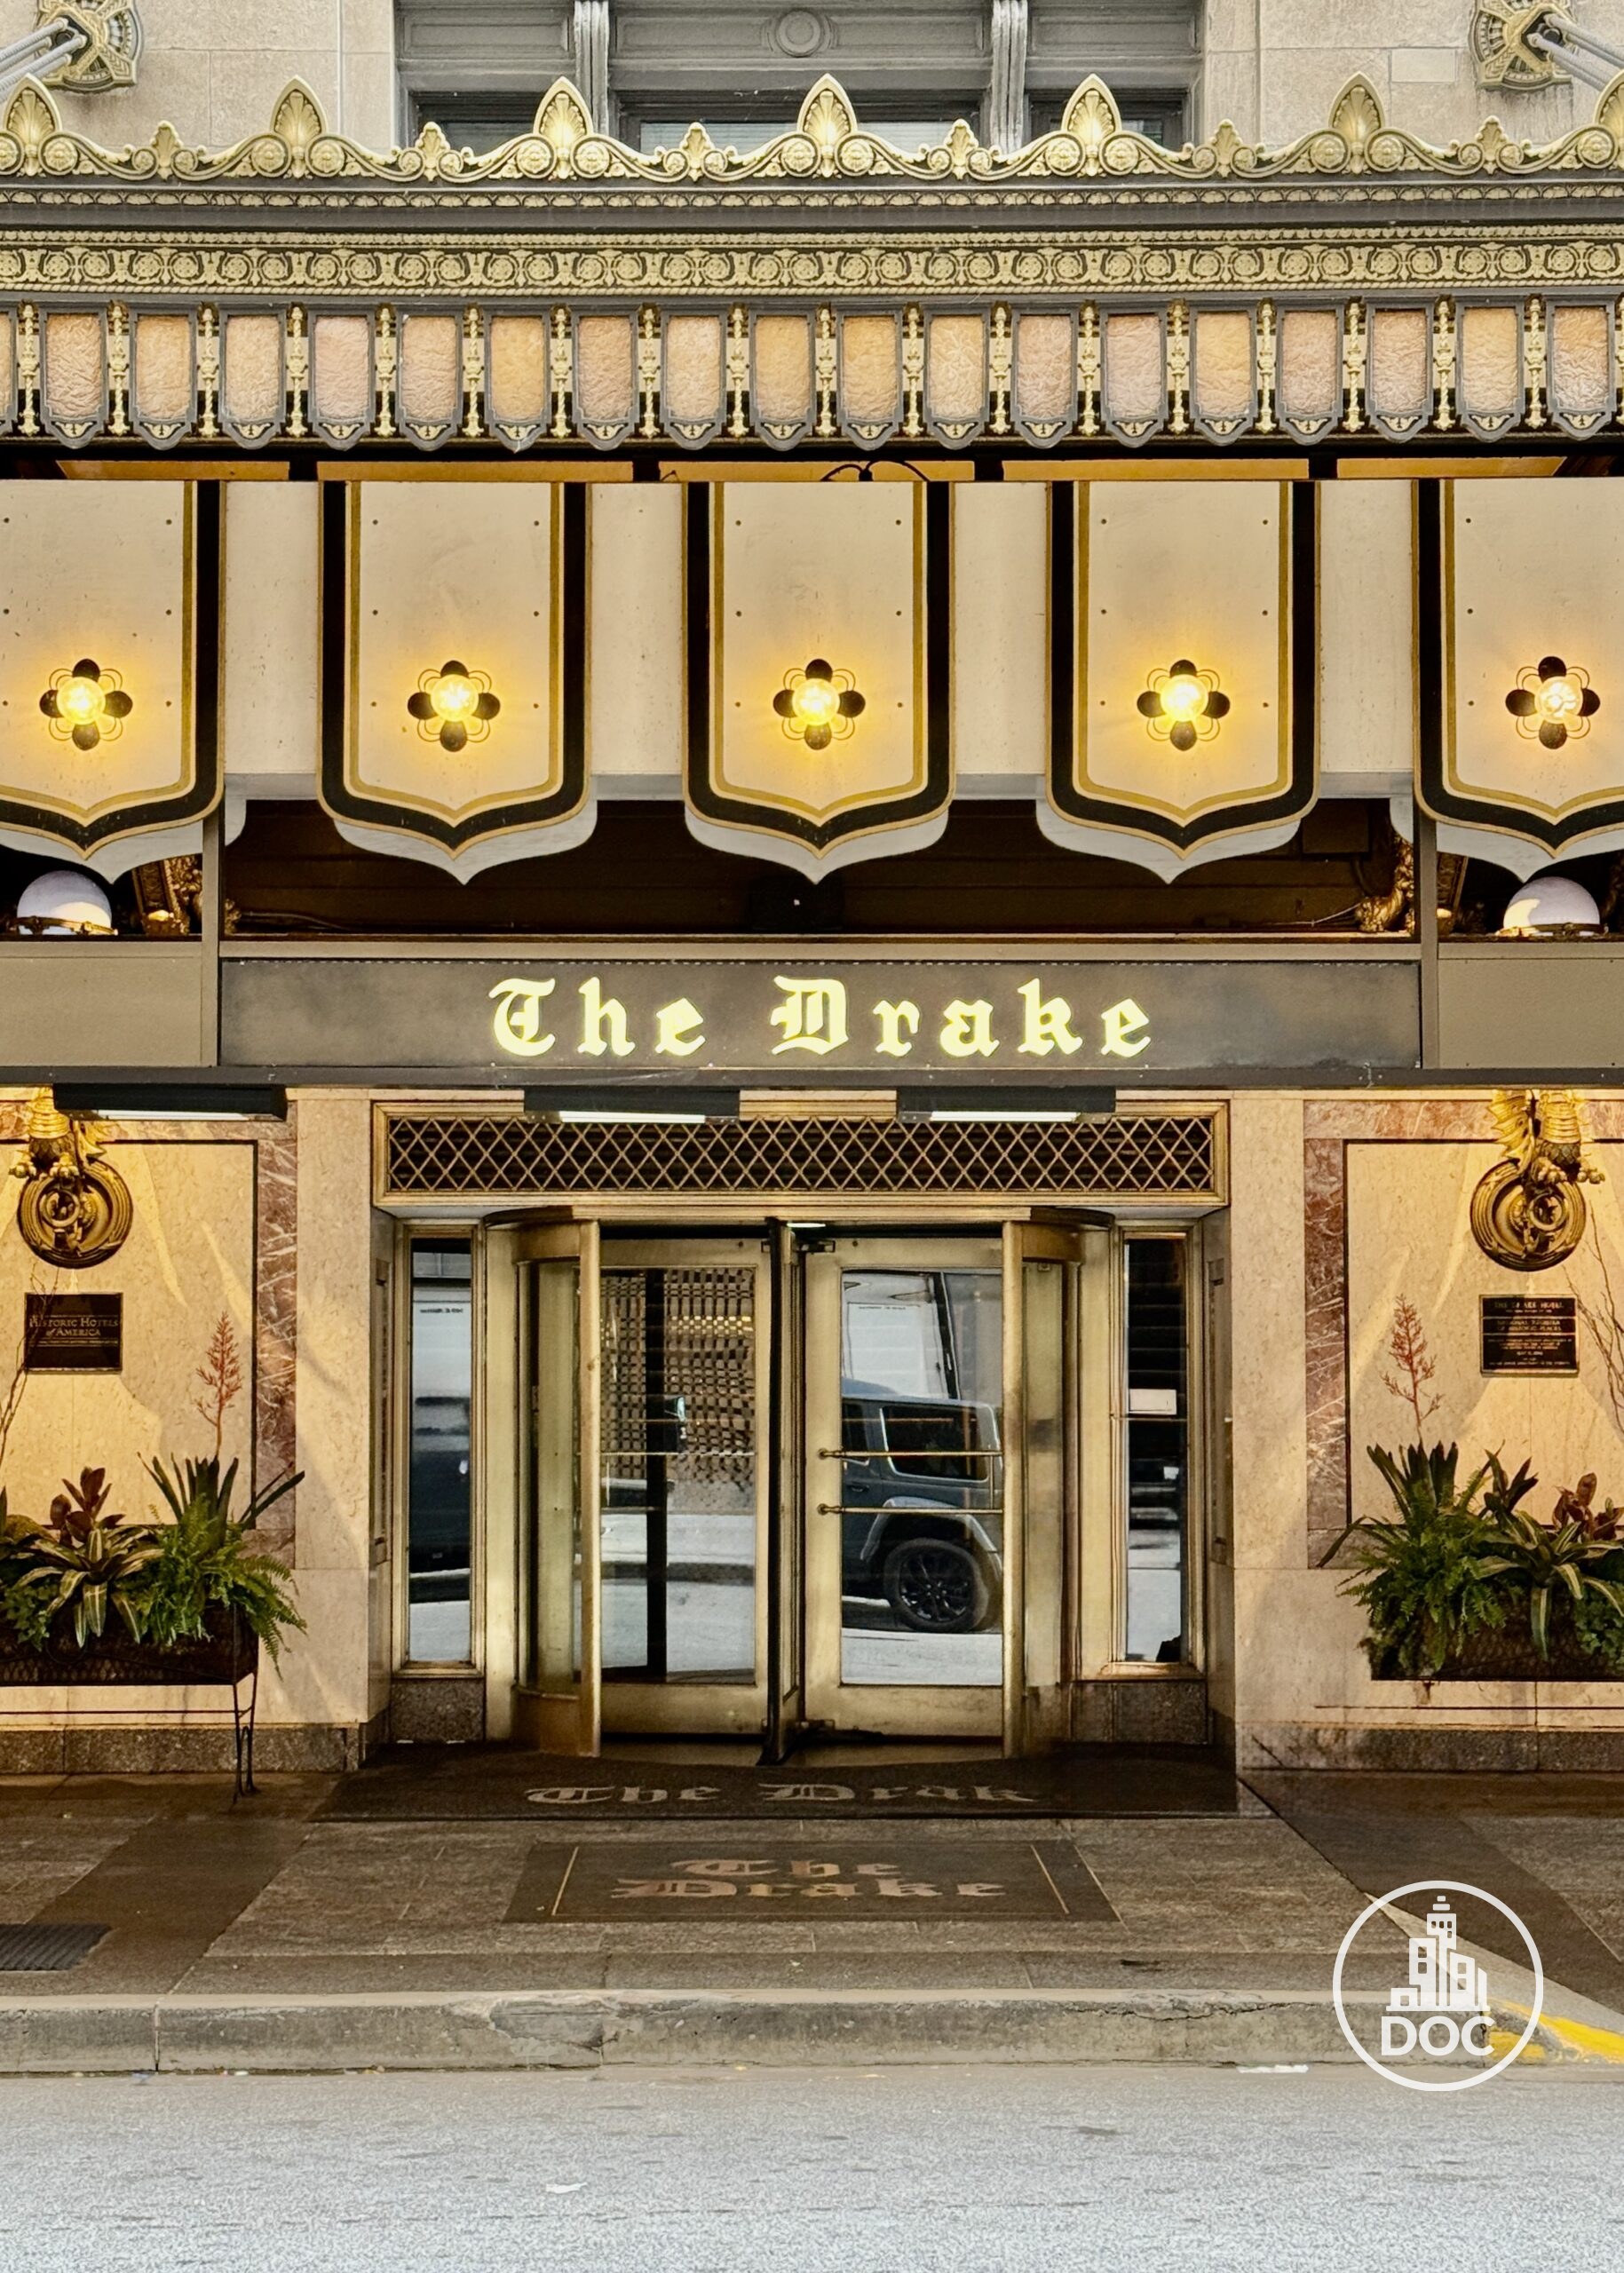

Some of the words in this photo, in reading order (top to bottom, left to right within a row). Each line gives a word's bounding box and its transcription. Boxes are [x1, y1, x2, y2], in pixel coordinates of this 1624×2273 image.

[488, 976, 707, 1057] The
[770, 975, 1152, 1057] Drake
[80, 1318, 118, 1327] HOTELS
[56, 1327, 101, 1336] AMERICA
[524, 1786, 721, 1803] The
[671, 1859, 901, 1877] The
[611, 1879, 1006, 1898] Drake
